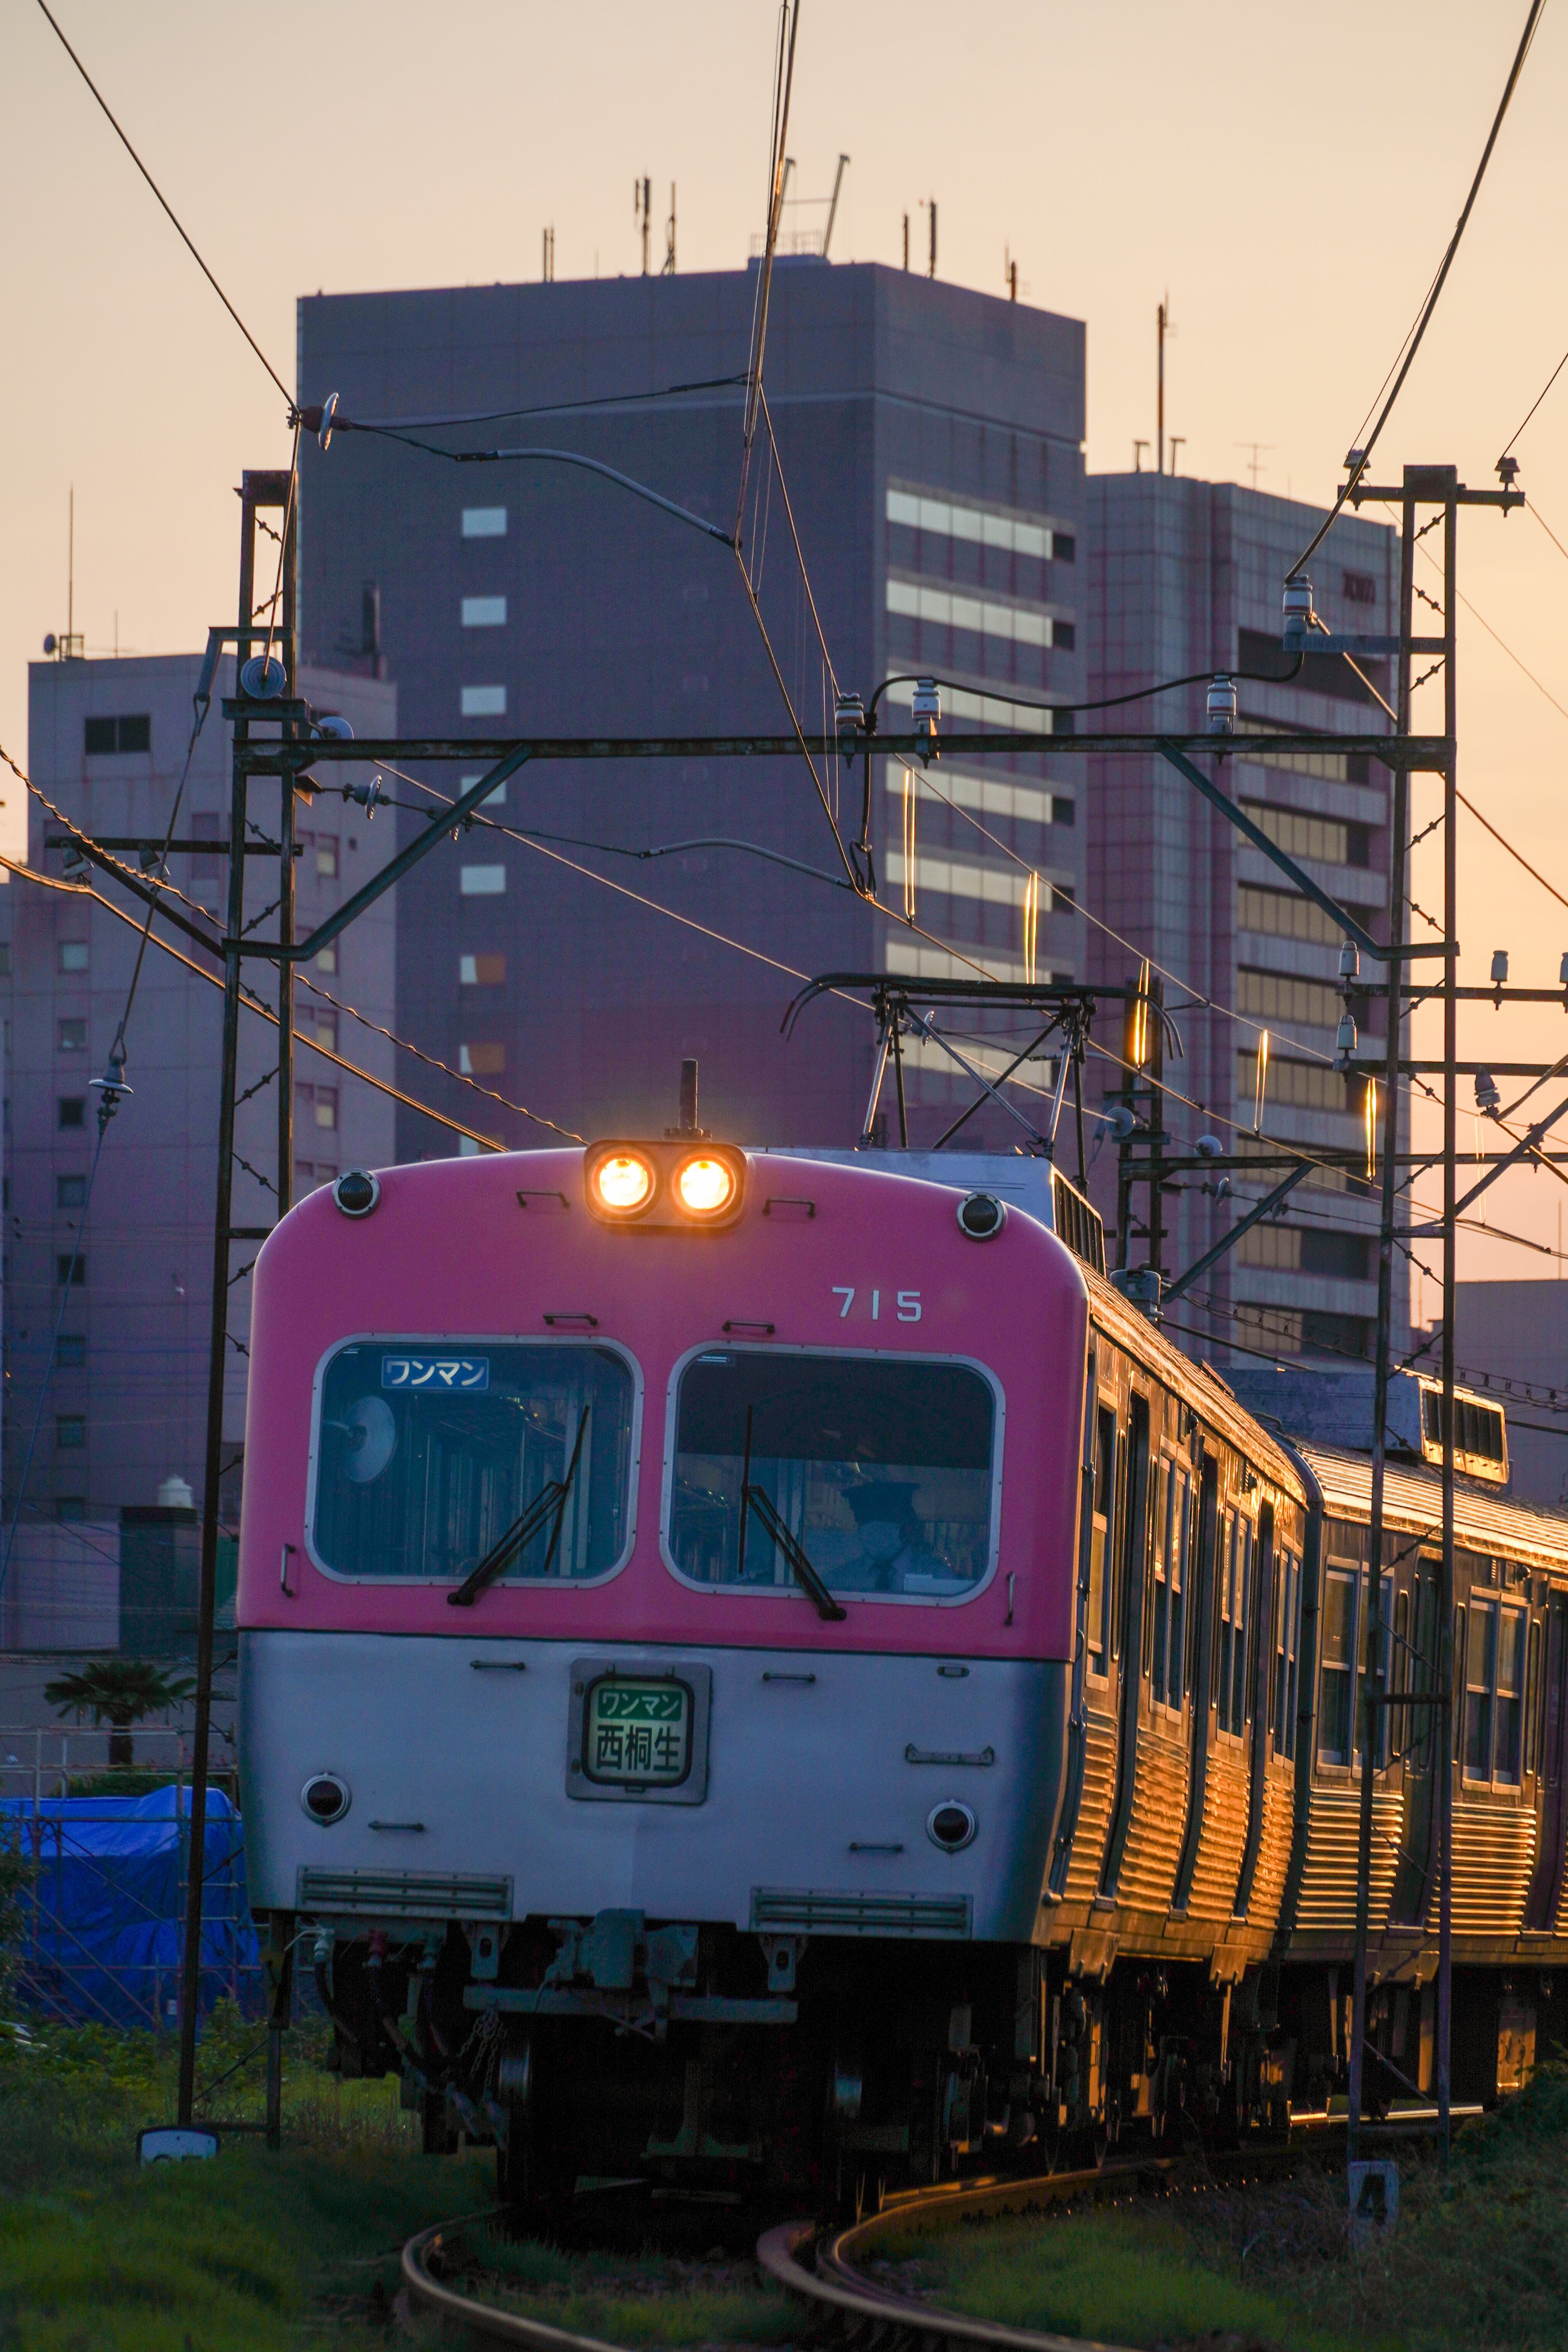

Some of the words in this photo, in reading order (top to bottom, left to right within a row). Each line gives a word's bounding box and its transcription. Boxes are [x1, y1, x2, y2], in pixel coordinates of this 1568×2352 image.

[831, 1286, 922, 1322] 715
[386, 1360, 485, 1386] ワンマン
[602, 1690, 679, 1717] ワンマン
[596, 1724, 681, 1773] 西桐生
